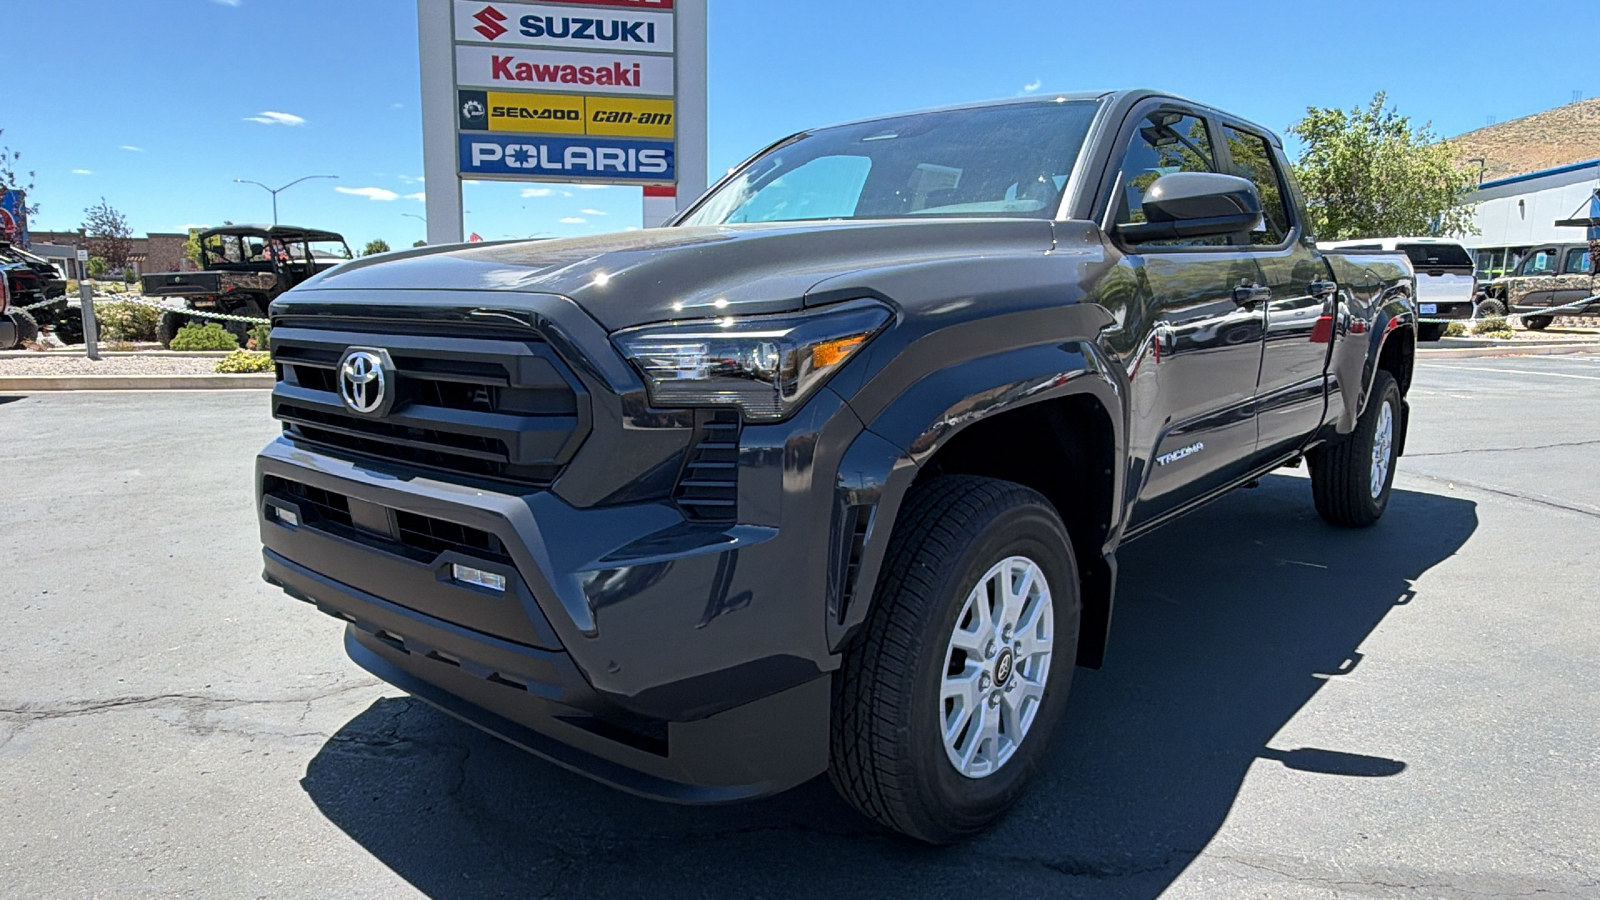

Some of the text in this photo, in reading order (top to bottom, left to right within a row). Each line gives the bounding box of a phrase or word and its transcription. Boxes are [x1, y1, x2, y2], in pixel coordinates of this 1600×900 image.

[519, 15, 655, 44] SUZUKI
[491, 55, 640, 87] Kawasaki
[592, 110, 672, 126] can-am
[471, 142, 668, 173] POLARIS
[1156, 441, 1204, 466] TACOMA
